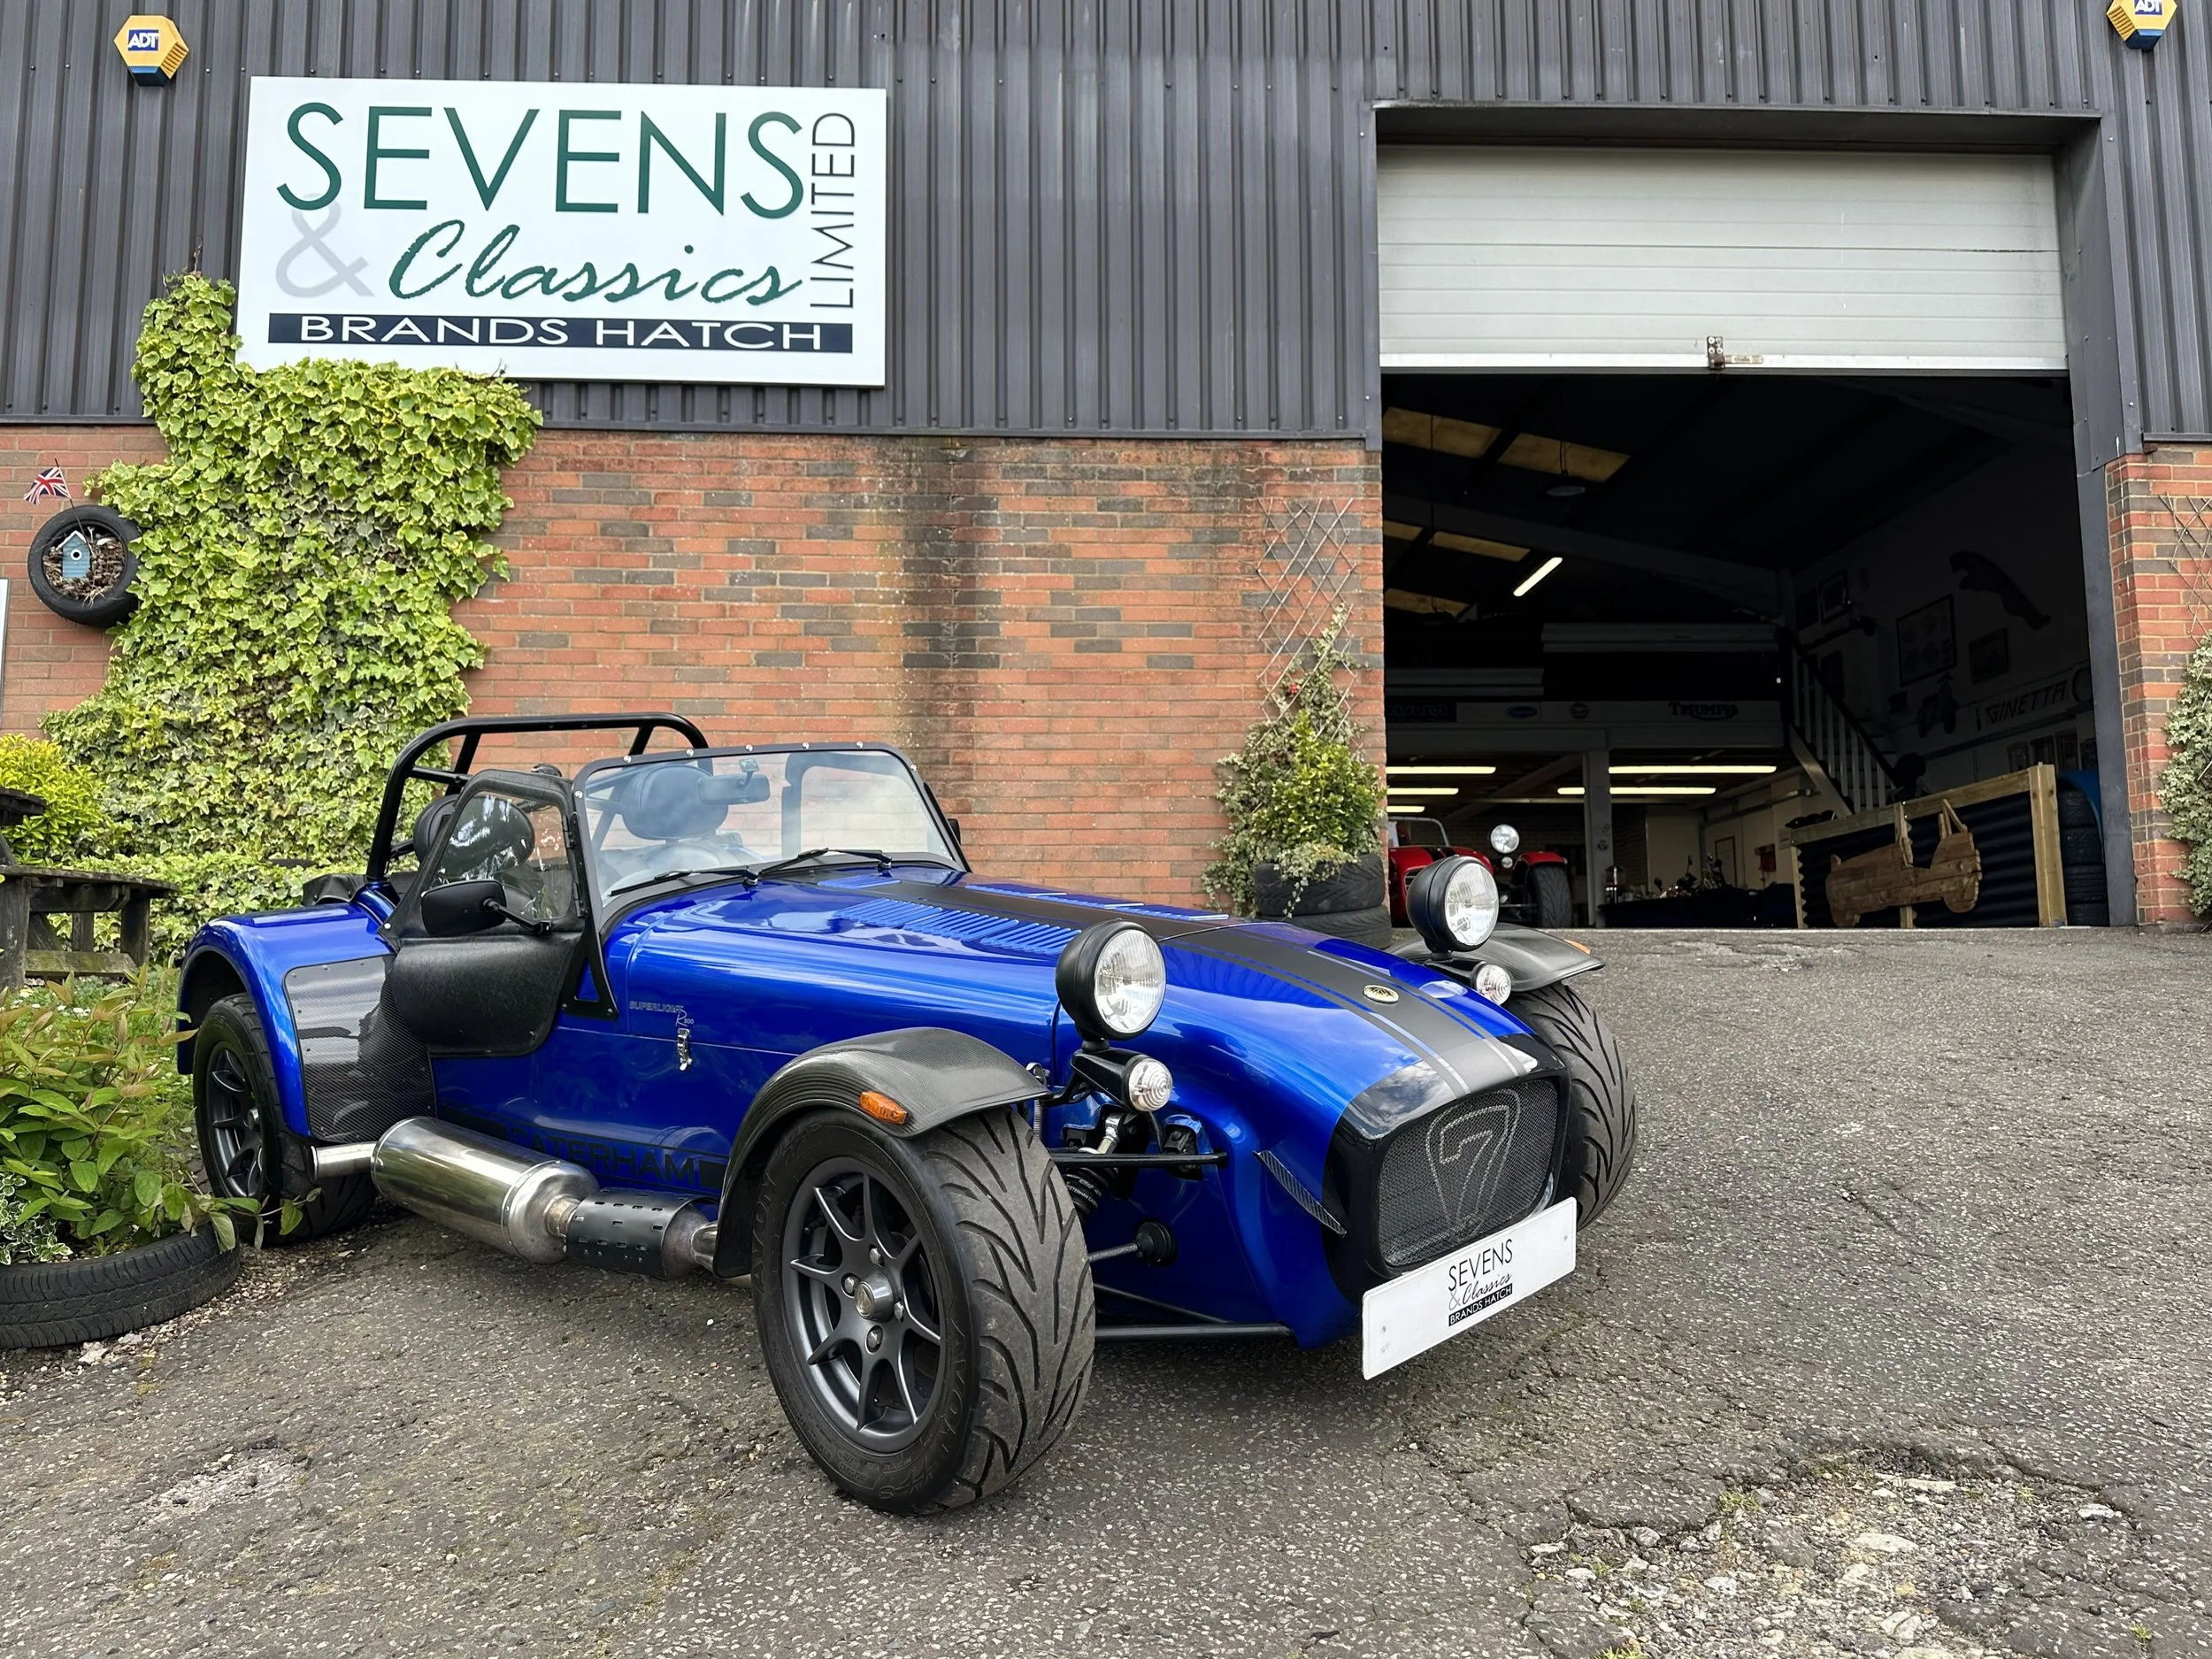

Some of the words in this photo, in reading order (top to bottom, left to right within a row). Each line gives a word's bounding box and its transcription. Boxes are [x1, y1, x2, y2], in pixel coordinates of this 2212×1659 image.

[2135, 0, 2161, 12] ADT
[128, 32, 159, 49] ADT
[277, 103, 803, 219] SEVENS
[810, 112, 856, 309] LIMITED
[275, 193, 375, 299] &
[388, 219, 803, 306] Classics
[300, 316, 568, 346] BRANDS
[595, 320, 821, 350] HATCH
[1985, 680, 2067, 724] GINETTA
[629, 1001, 684, 1013] SUPERLIGHT
[511, 1127, 695, 1184] CATERHAM
[1448, 1239, 1512, 1292] SEVENS
[1448, 1288, 1461, 1310] &
[1463, 1272, 1512, 1305] Classics
[1450, 1300, 1483, 1325] BRANDS
[1485, 1285, 1512, 1307] HATCH
